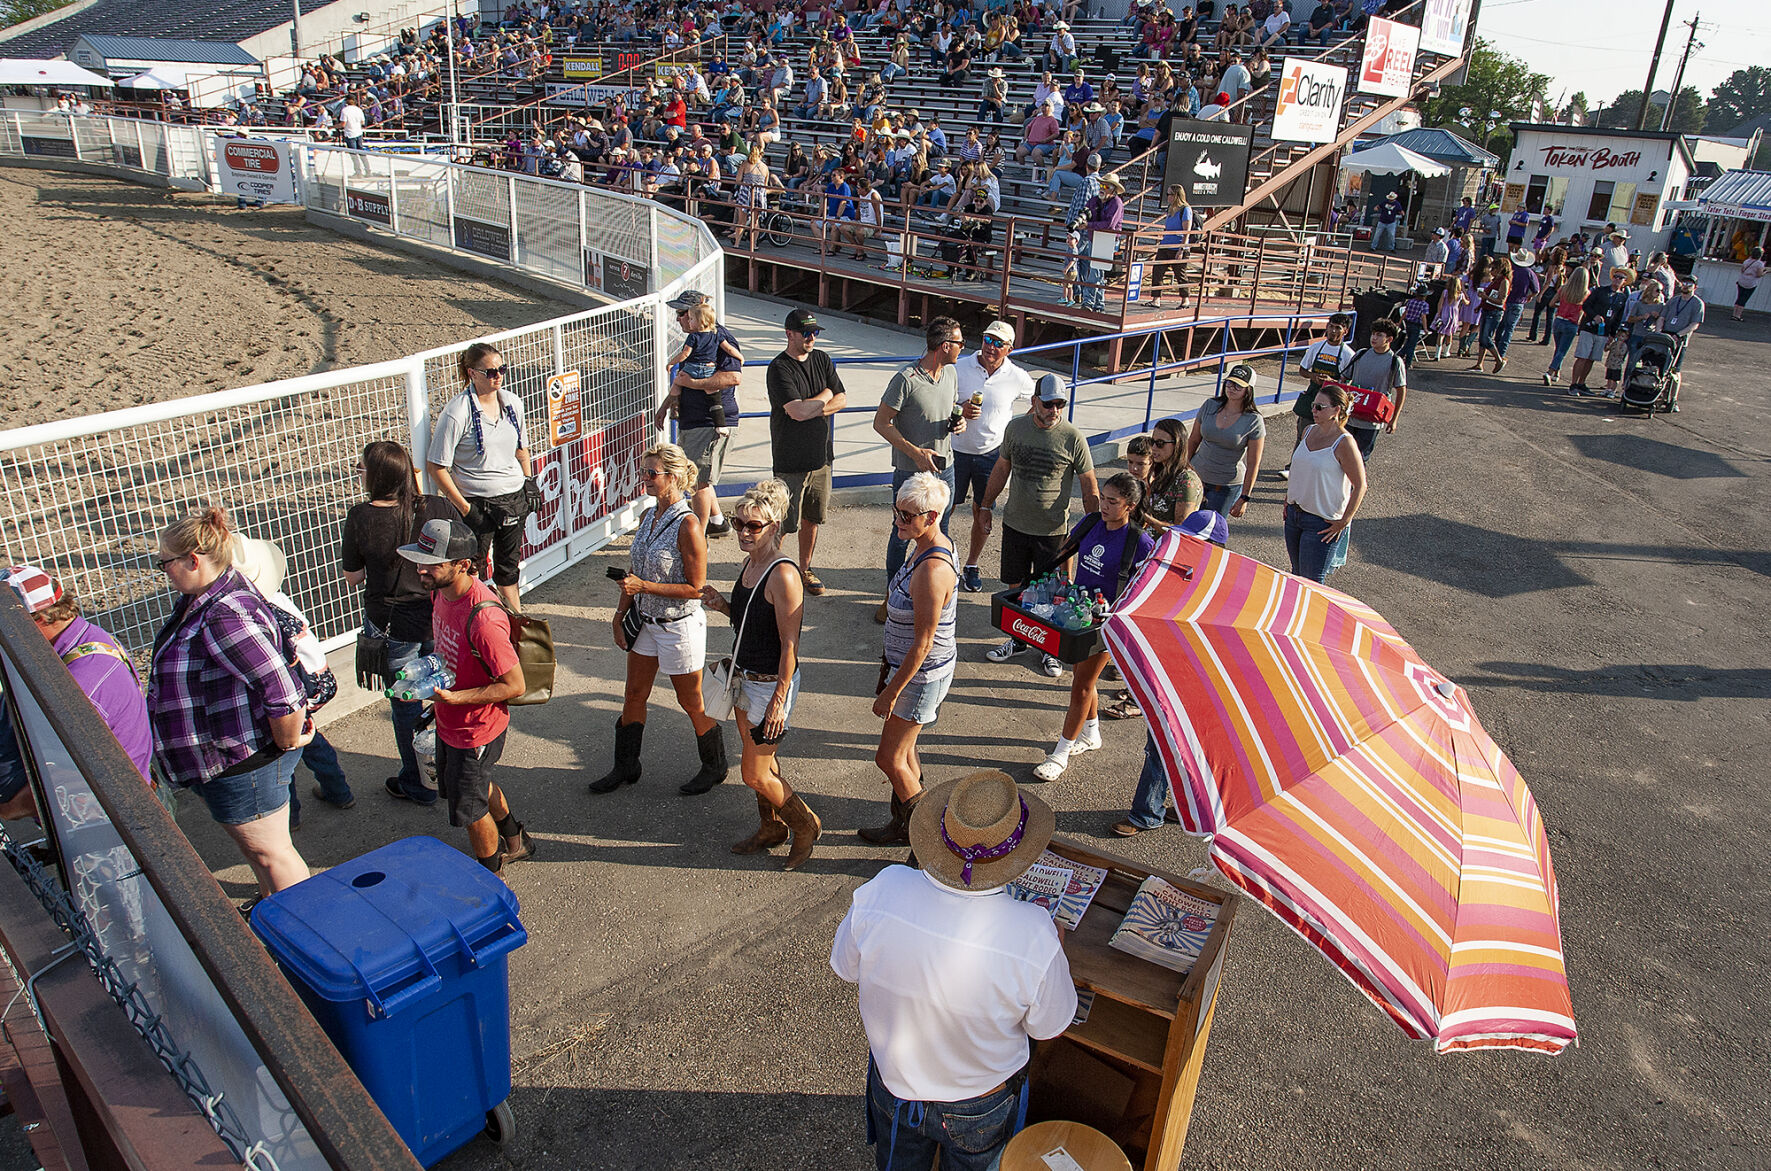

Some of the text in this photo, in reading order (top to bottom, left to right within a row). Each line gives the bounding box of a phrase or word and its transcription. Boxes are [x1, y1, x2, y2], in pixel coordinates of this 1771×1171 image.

[565, 61, 600, 72] KENDALL
[1386, 48, 1412, 73] REEL
[1297, 73, 1342, 119] Clarity
[1174, 131, 1192, 141] ENJOY
[1191, 133, 1196, 142] A
[1196, 134, 1211, 143] COLD
[1211, 135, 1222, 144] ONE
[227, 146, 276, 160] COMMERCIAL
[243, 158, 262, 169] TIRE
[364, 201, 389, 216] SUPPLY
[1707, 205, 1721, 214] Tater
[1723, 207, 1735, 216] Tots
[1739, 209, 1757, 218] Finger
[564, 381, 579, 394] FREE
[564, 391, 580, 404] ZONE
[1012, 618, 1049, 644] Coca-Cola
[1015, 878, 1032, 888] GHT
[1033, 883, 1057, 894] RODEO
[1021, 873, 1054, 887] ALDWELL
[1153, 889, 1212, 918] NIGHT RODEO
[1162, 889, 1206, 913] CALDWELL
